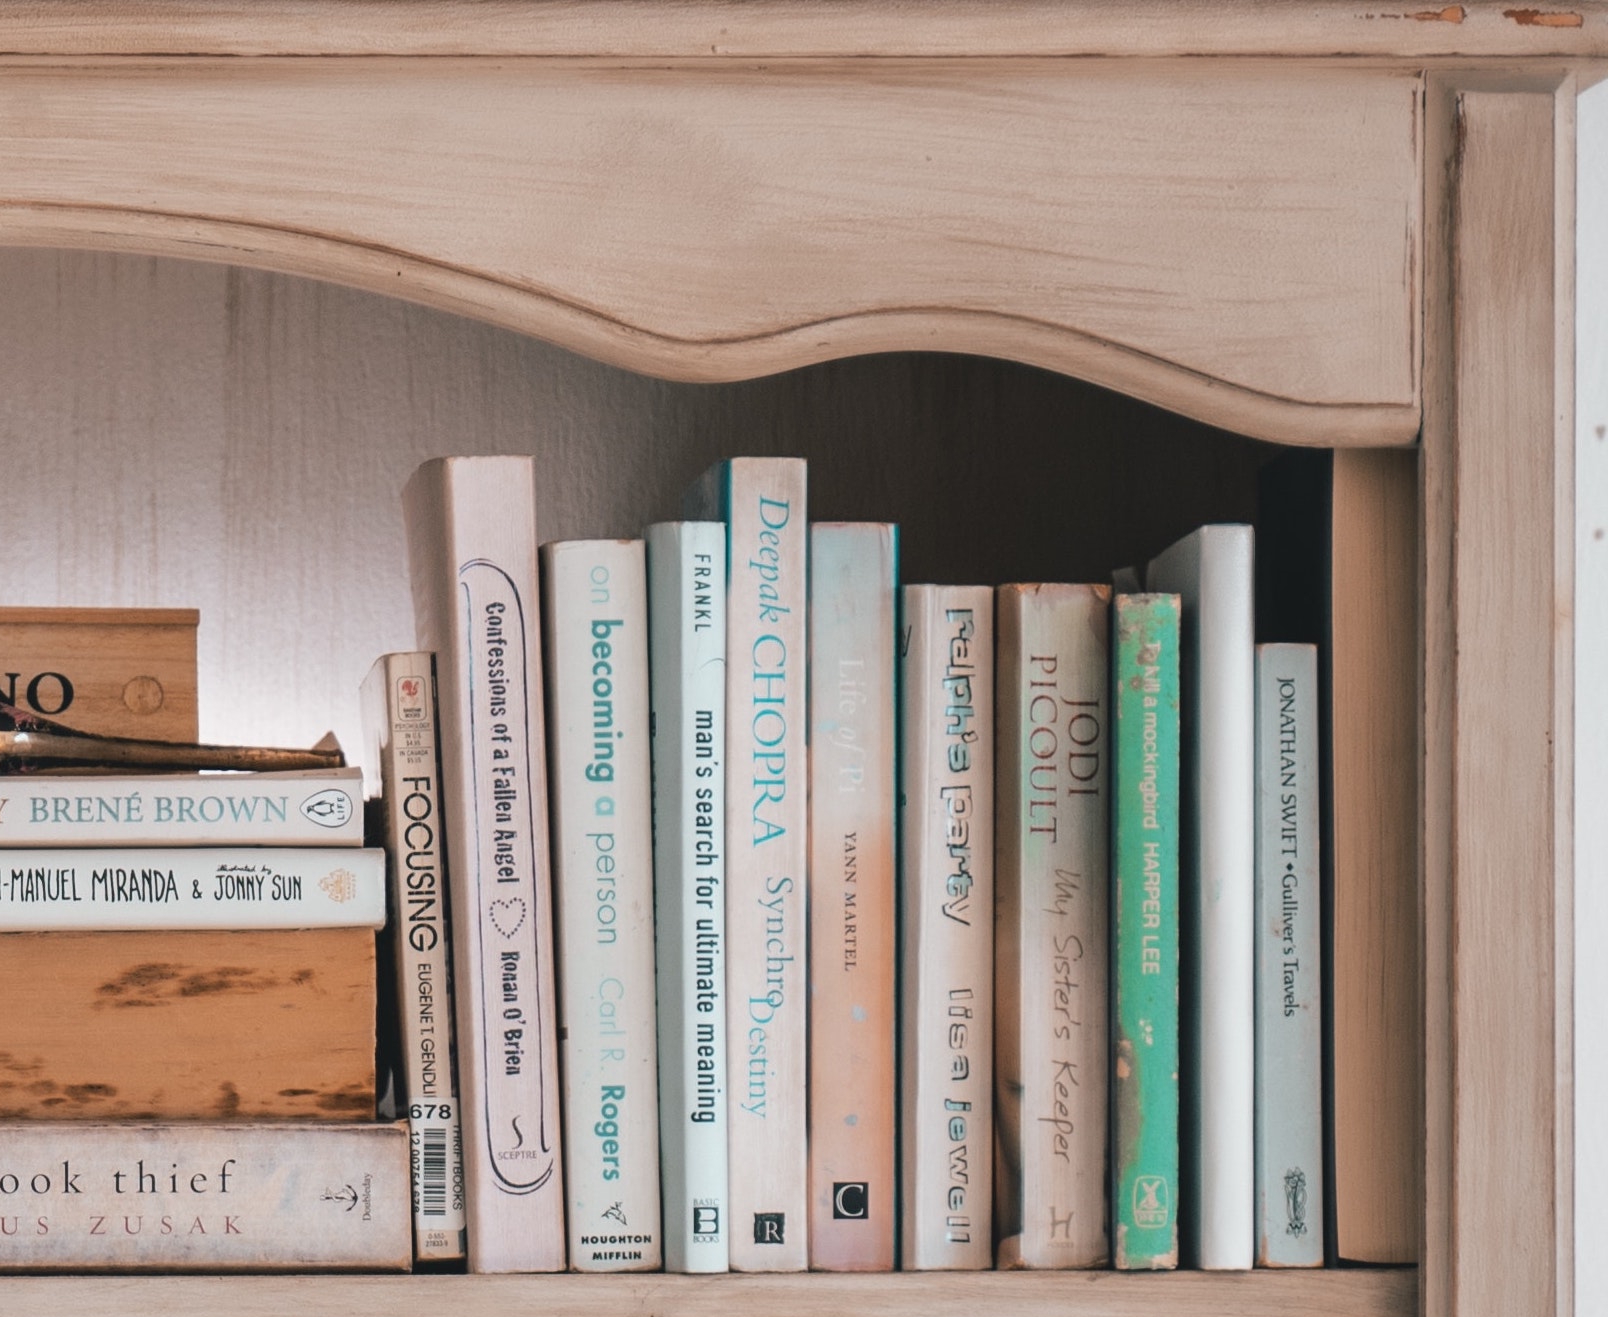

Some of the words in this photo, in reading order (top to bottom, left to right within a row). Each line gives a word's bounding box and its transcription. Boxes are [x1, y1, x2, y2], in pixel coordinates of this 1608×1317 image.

[695, 554, 711, 633] FRANKL
[696, 711, 718, 778] man's
[1279, 677, 1298, 786] JONATHAN
[696, 789, 720, 866] search
[1282, 793, 1298, 858] SWIFT
[90, 866, 177, 903] MIRANDA
[190, 881, 201, 898] &
[212, 875, 263, 901] JONNY
[270, 877, 300, 901] SUN
[845, 831, 857, 886] YANN
[696, 877, 720, 908] for
[1282, 873, 1298, 953] Gulliver's
[845, 892, 858, 972] MARTEL
[696, 919, 720, 1014] ultimate
[1282, 957, 1298, 1017] Travels
[692, 1024, 720, 1124] meaning
[113, 1160, 235, 1193] thief
[88, 1215, 243, 1236] ZUSAK
[580, 1236, 652, 1244] HOUGHTON
[592, 1252, 643, 1261] MIFFLIN
